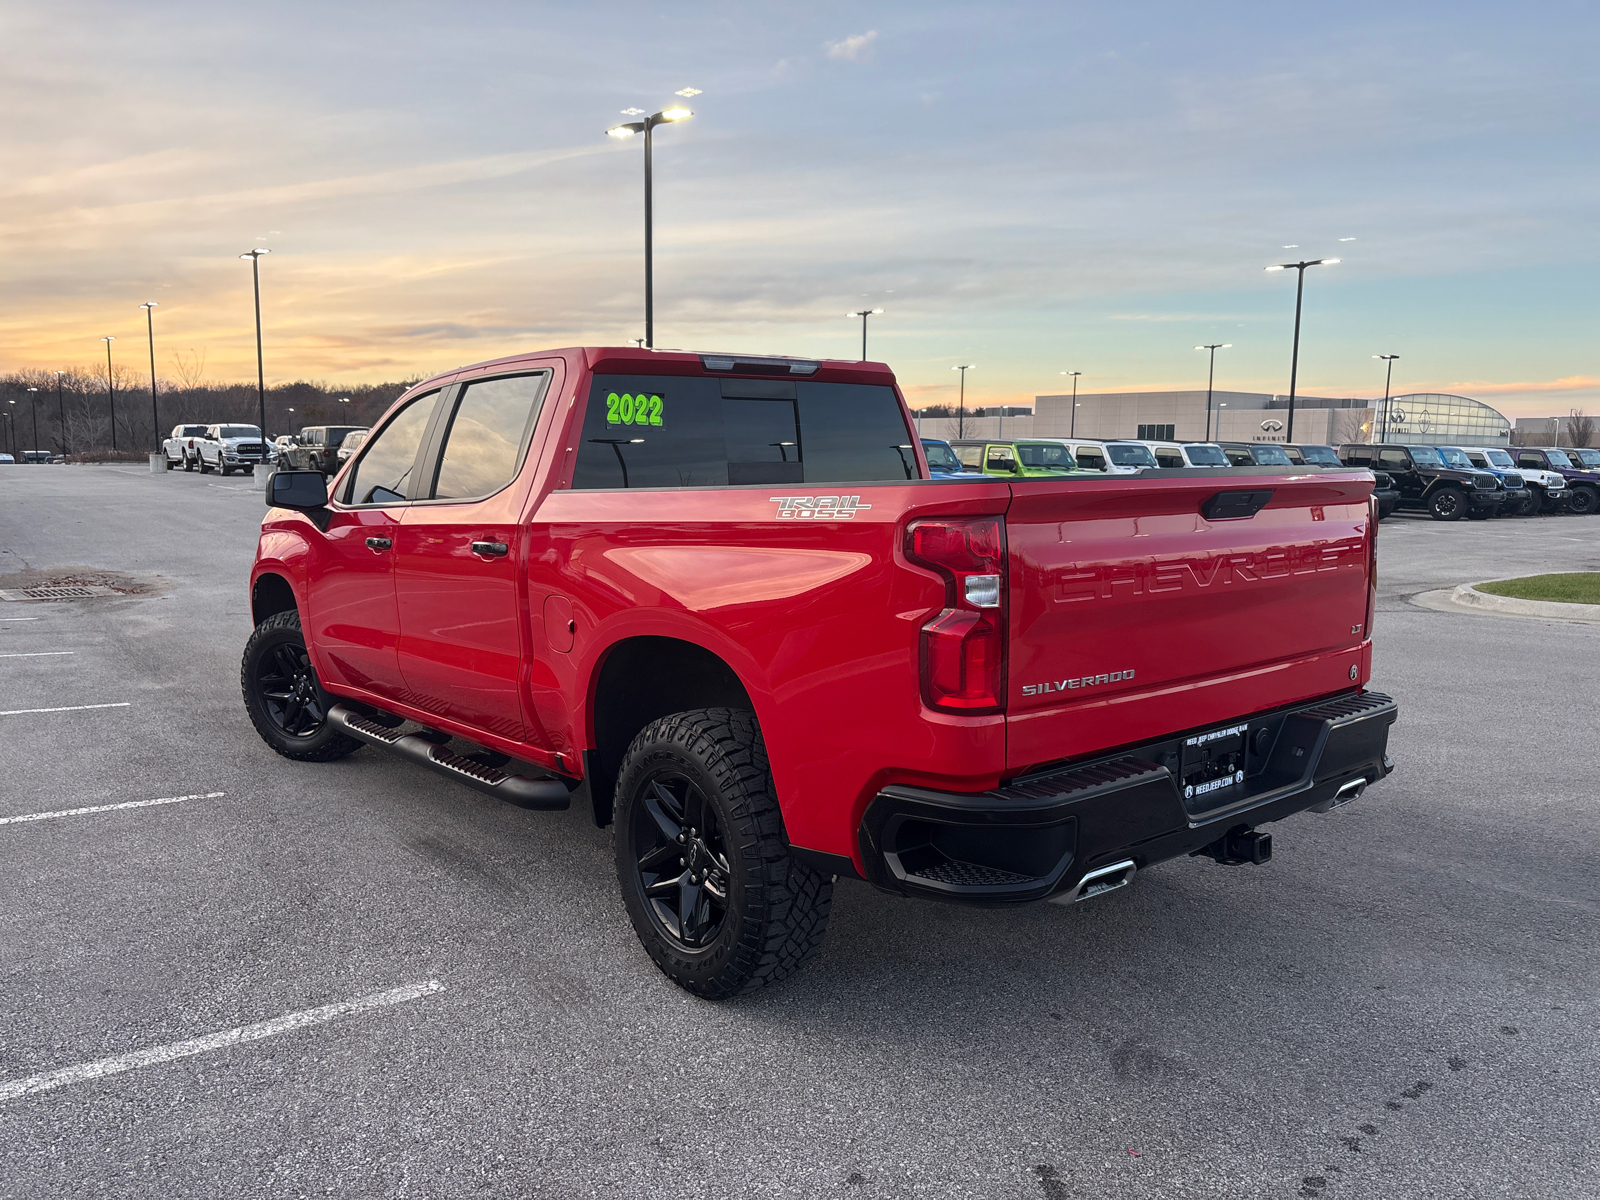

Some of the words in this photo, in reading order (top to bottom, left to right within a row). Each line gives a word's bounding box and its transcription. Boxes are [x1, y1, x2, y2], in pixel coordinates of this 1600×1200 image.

[605, 392, 664, 427] 2022
[769, 495, 872, 511] TRAIL
[775, 508, 858, 520] BOSS
[1053, 543, 1362, 604] CHEVROLET
[1350, 623, 1363, 635] LT
[1021, 669, 1136, 697] SILVERADO
[1187, 738, 1198, 746] REED
[1195, 776, 1233, 796] REEDJEEP.COM
